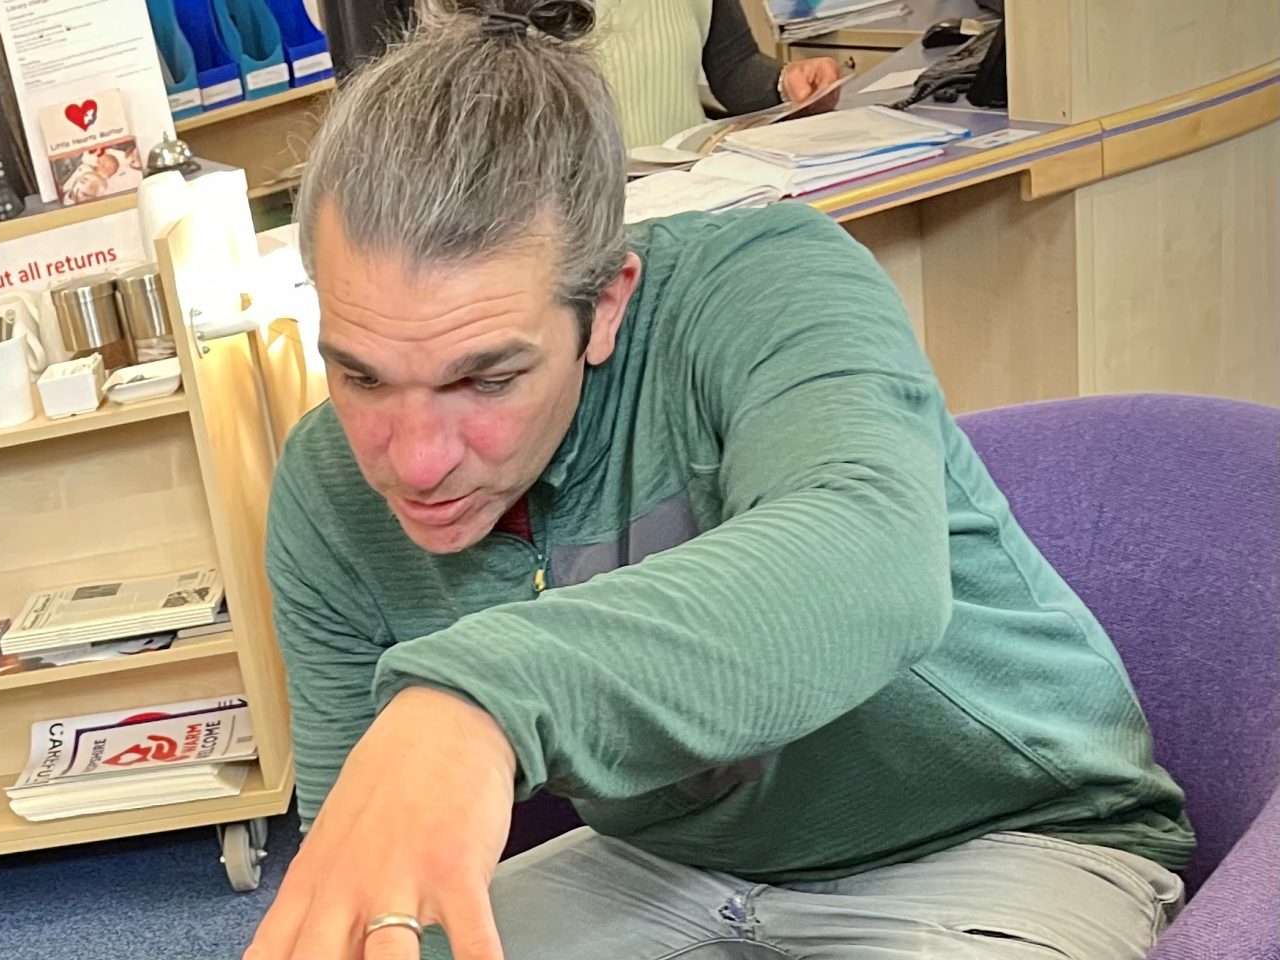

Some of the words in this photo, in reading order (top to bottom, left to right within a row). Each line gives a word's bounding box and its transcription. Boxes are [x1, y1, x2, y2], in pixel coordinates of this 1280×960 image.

[18, 261, 41, 283] all
[46, 248, 117, 277] returns
[181, 722, 203, 754] WARM
